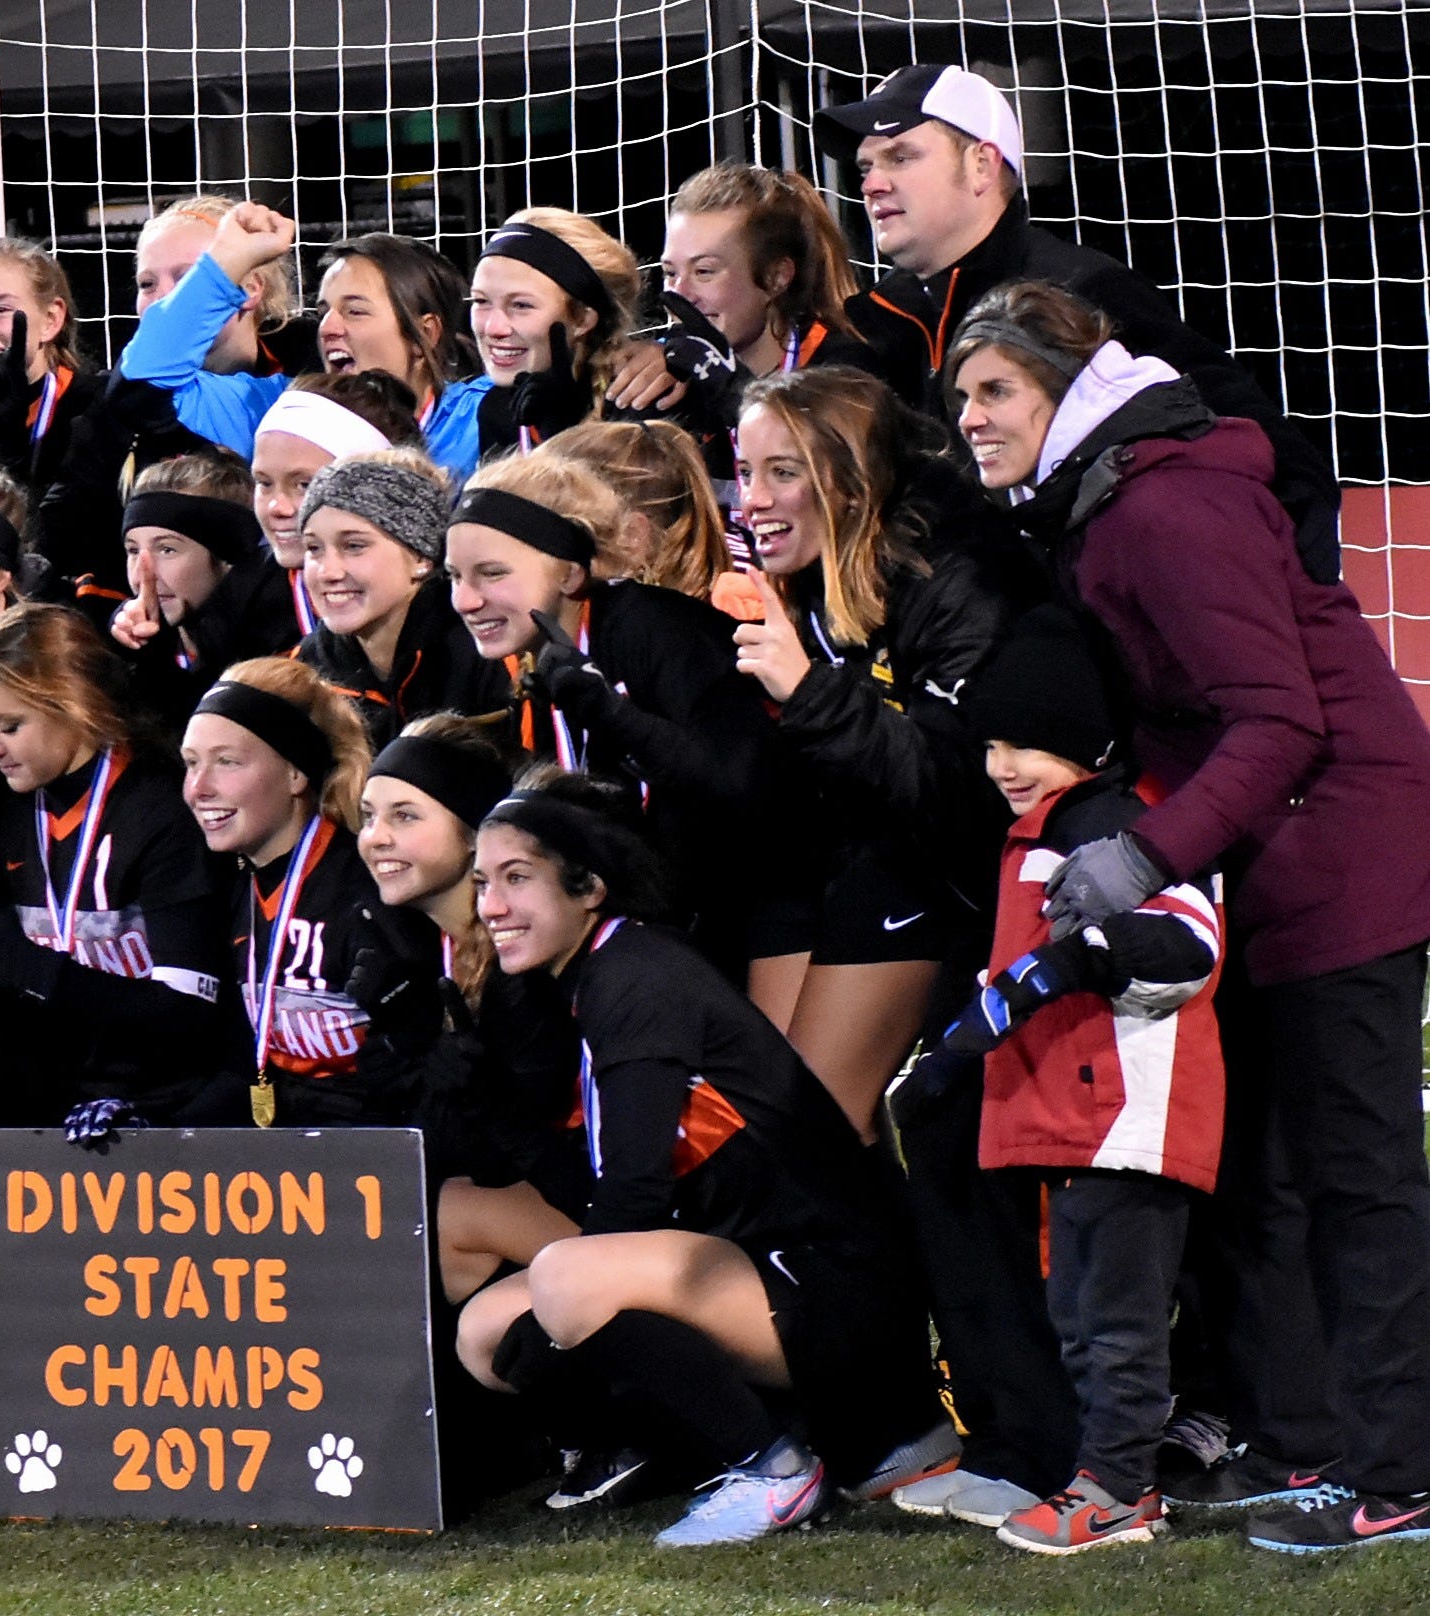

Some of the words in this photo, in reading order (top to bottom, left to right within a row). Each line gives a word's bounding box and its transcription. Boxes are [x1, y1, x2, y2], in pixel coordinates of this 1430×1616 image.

[284, 918, 326, 990] 21
[6, 1170, 326, 1236] DIVISION
[356, 1175, 382, 1240] 1
[84, 1253, 288, 1323] STATE
[45, 1343, 324, 1411] CHAMPS
[113, 1427, 272, 1492] 2017
